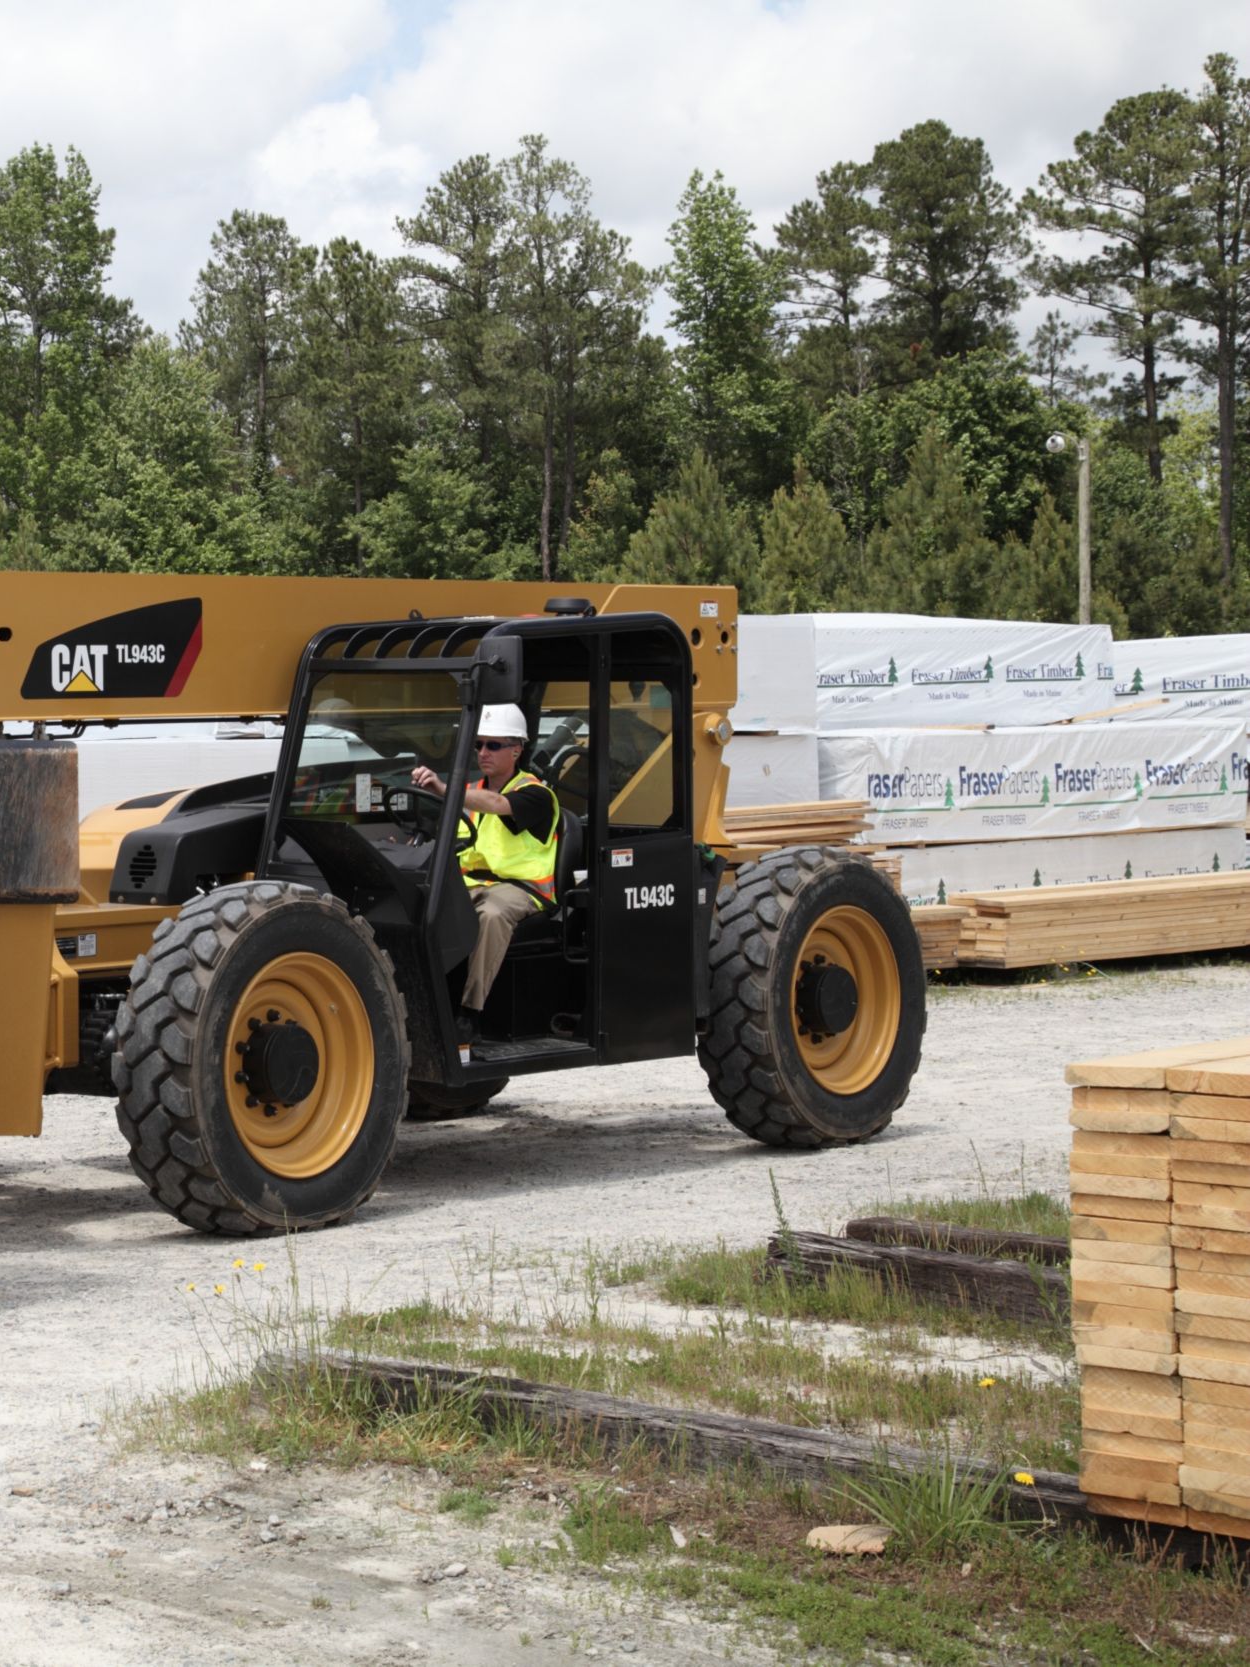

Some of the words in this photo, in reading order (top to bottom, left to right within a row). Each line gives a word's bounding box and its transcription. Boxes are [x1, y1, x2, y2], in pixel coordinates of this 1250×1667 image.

[116, 643, 166, 664] TL943C
[51, 643, 109, 692] CAT
[911, 668, 945, 683] Fraser
[949, 666, 983, 681] Timber
[1006, 664, 1037, 679] Fraser
[1039, 663, 1074, 679] Timber
[849, 668, 887, 684] Timber
[1162, 677, 1207, 691] Fraser
[928, 692, 943, 700] Made
[1023, 689, 1038, 698] Made
[1185, 699, 1208, 709] Made
[959, 765, 1040, 803] FraserPapers
[1054, 761, 1133, 799] FraserPapers
[882, 817, 908, 831] FRASER
[981, 814, 1005, 827] FRASER
[1006, 813, 1027, 825] TIMBER
[624, 883, 675, 910] TL943C
